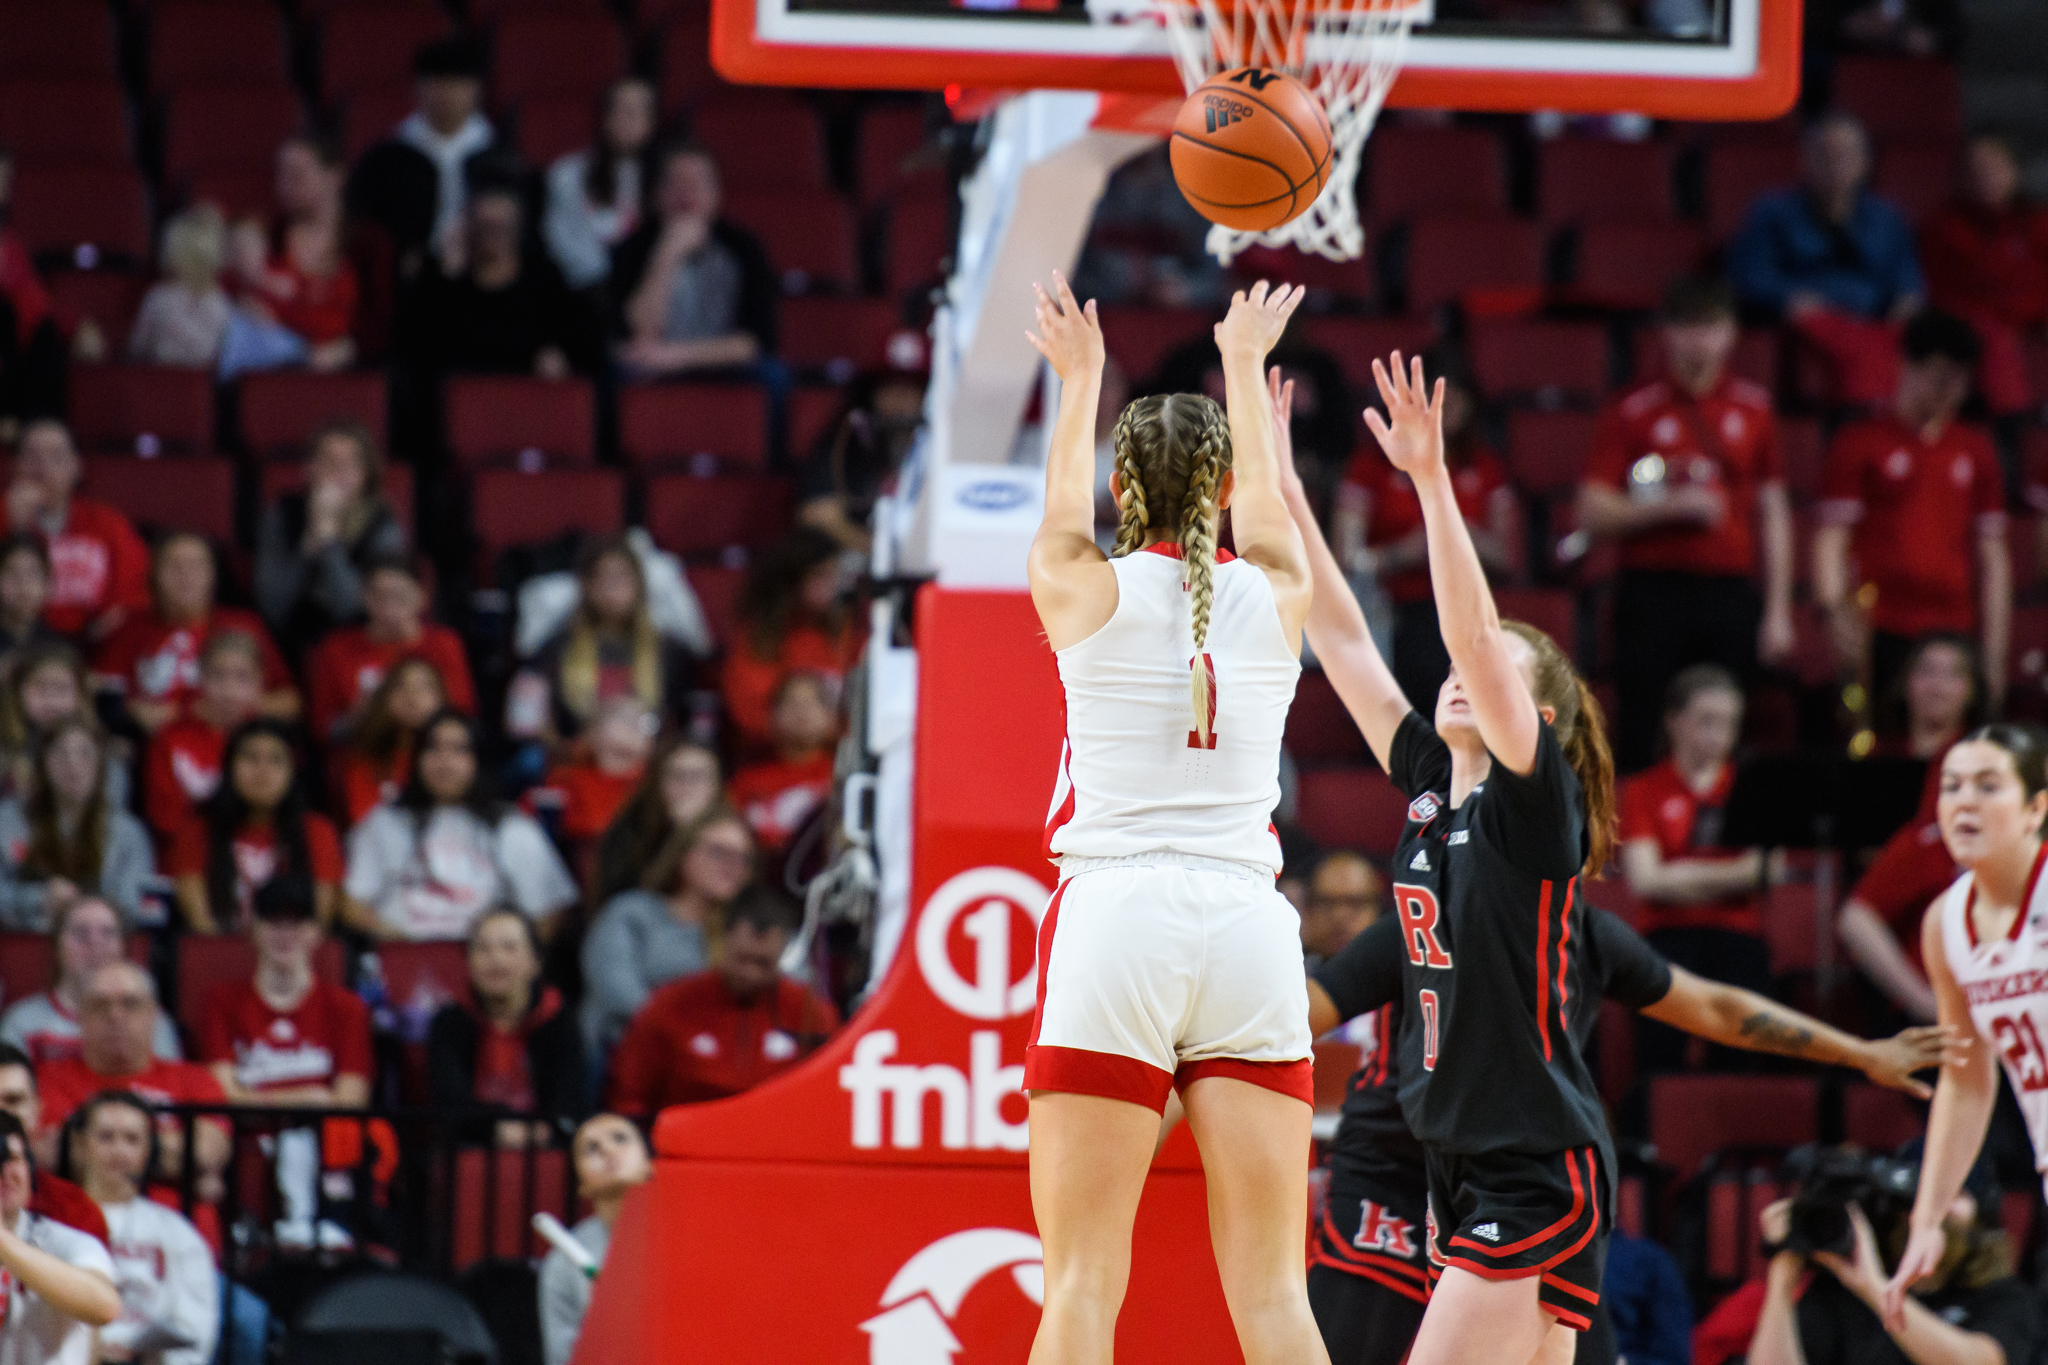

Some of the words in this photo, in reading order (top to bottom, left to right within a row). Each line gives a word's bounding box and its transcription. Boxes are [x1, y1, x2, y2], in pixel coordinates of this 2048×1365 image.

[1203, 94, 1254, 118] adidas
[1393, 882, 1453, 969] R
[1419, 988, 1439, 1071] 0
[839, 1028, 1030, 1153] fnb
[1471, 1227, 1501, 1242] adidas
